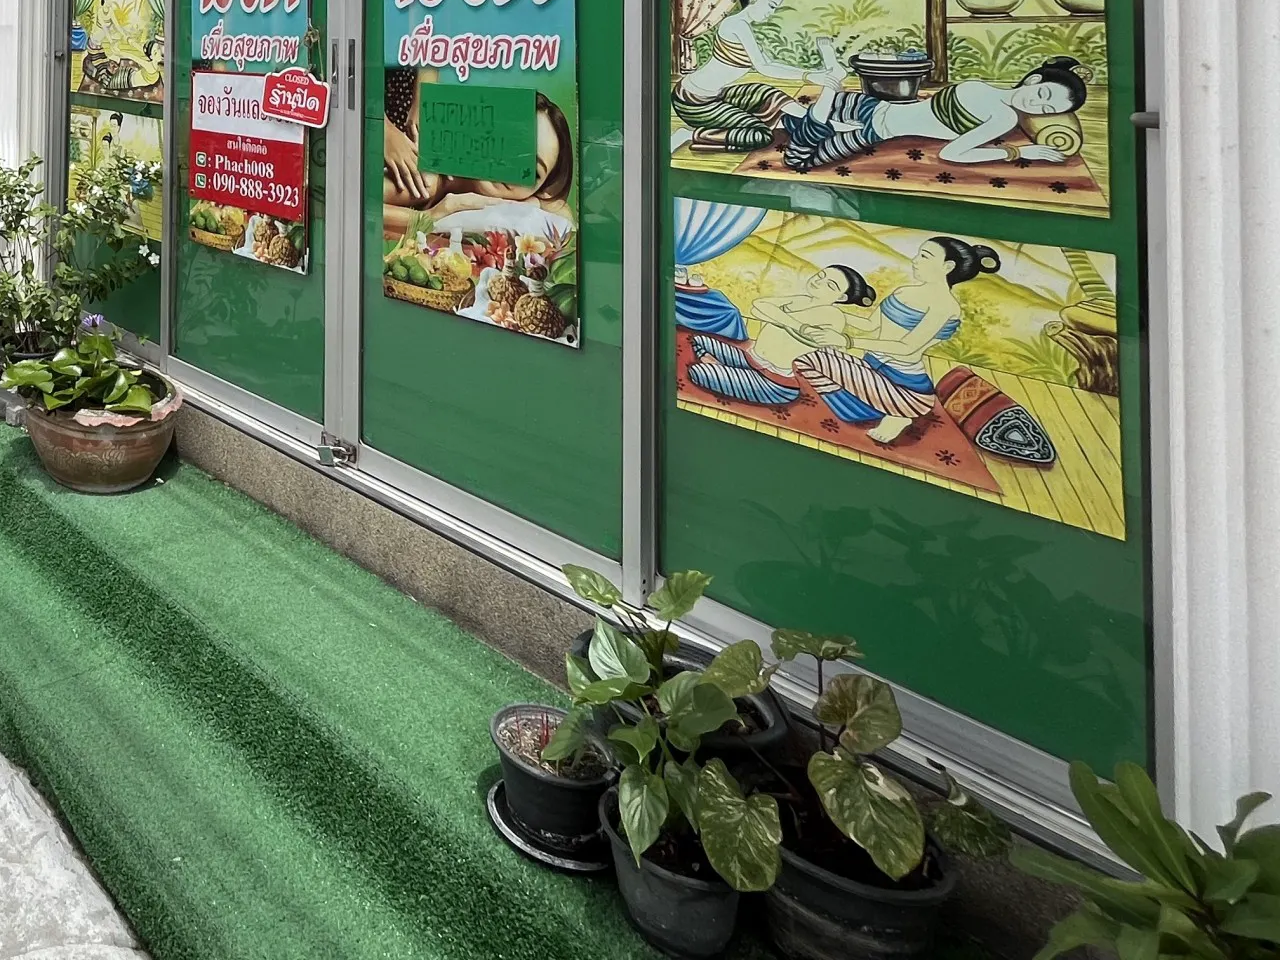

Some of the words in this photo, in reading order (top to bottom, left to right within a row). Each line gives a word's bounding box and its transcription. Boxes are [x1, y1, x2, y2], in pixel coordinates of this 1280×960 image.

[200, 21, 300, 71] เพื่อสุขภาพ
[399, 16, 560, 80] เพื่อสุขภาพ
[284, 73, 310, 86] CLOSED
[269, 83, 320, 112] ร้านปิด
[215, 154, 275, 180] Phach008
[213, 172, 300, 208] 090-888-3923
